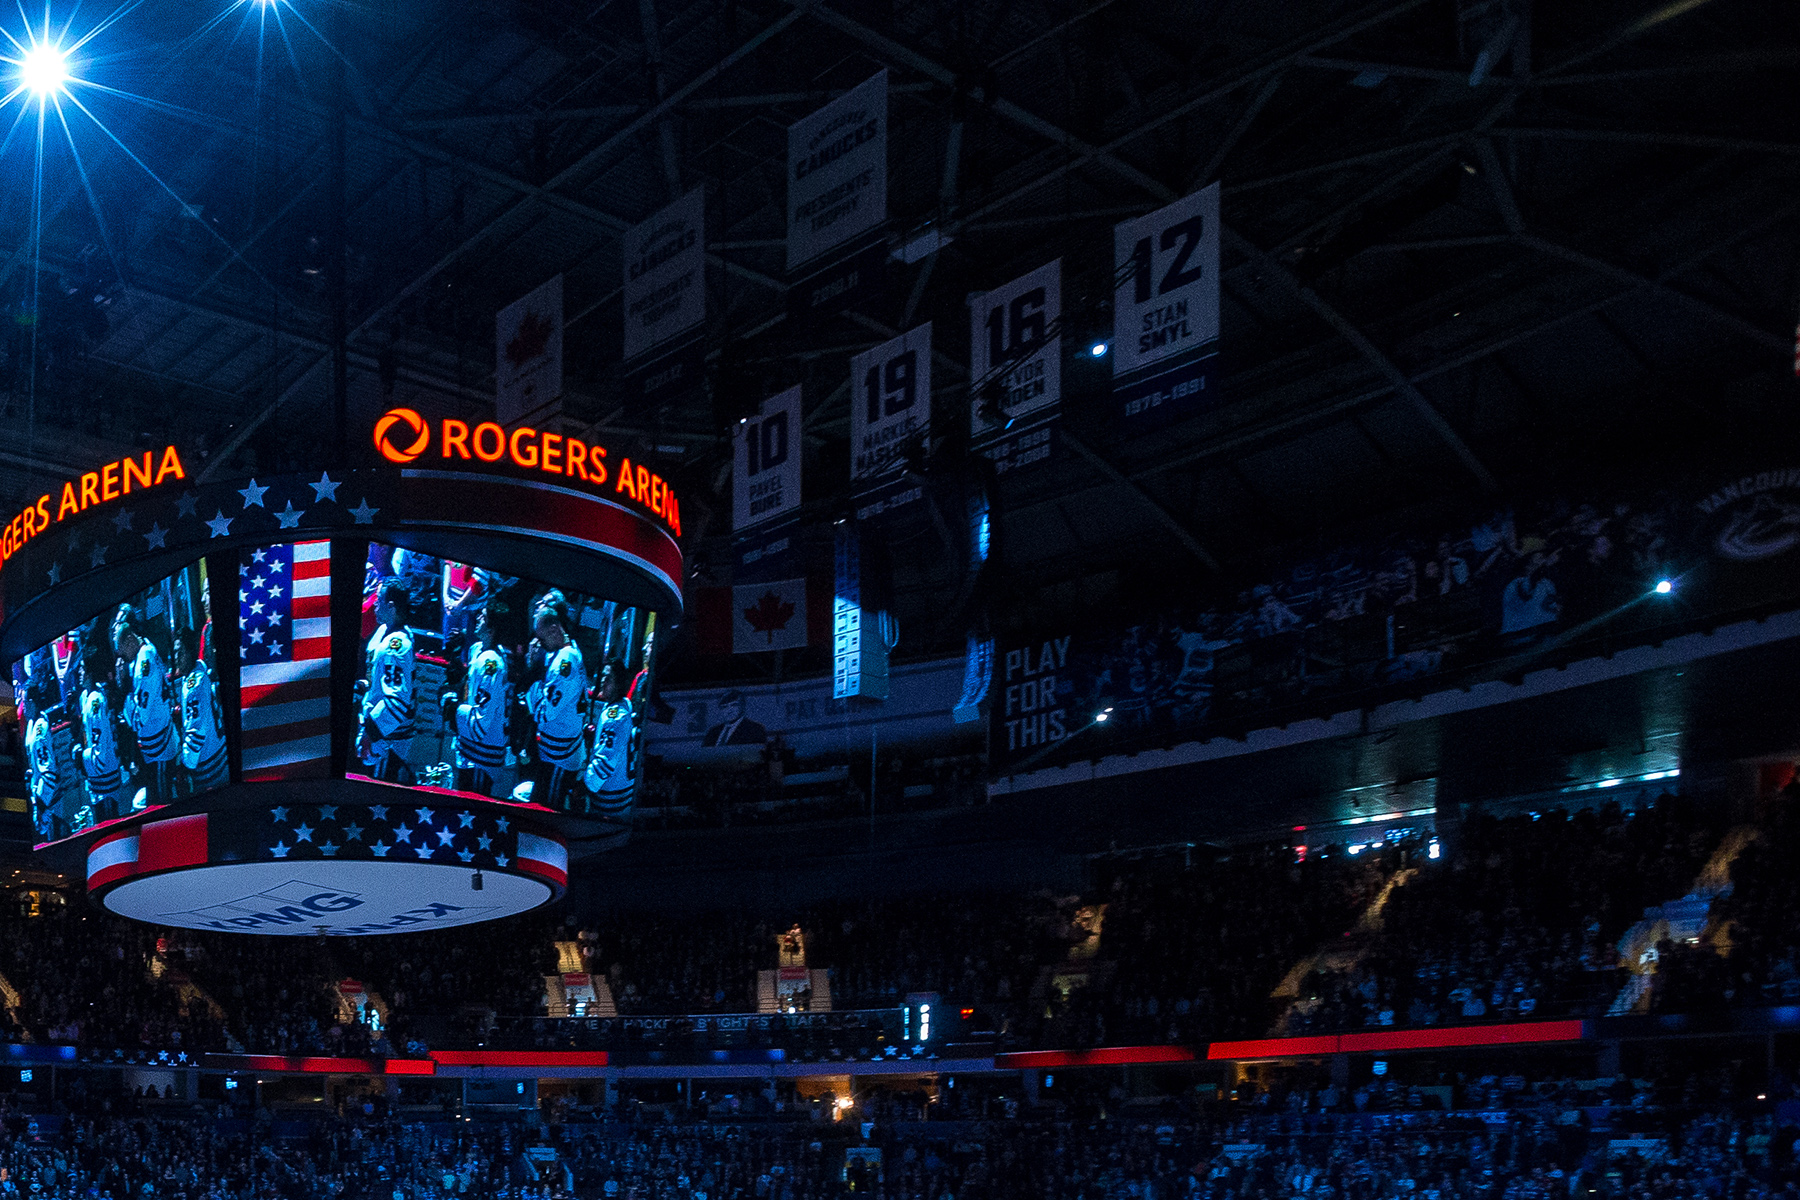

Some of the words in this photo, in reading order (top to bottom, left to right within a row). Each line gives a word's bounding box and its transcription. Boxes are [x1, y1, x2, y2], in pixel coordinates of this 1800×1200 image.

[796, 117, 878, 180] CANUCKS
[1132, 215, 1203, 304] 12
[986, 286, 1045, 367] 16
[1139, 319, 1192, 354] SMYL
[1143, 299, 1189, 332] STAN
[864, 350, 916, 424] 19
[746, 410, 788, 477] 10
[863, 416, 918, 449] MARKUS
[56, 444, 186, 523] ARENA
[442, 418, 608, 485] ROGERS
[616, 448, 682, 538] ARENA
[1696, 467, 1800, 514] VANCOUV
[1005, 634, 1072, 683] PLAY
[1005, 675, 1058, 718] FOR
